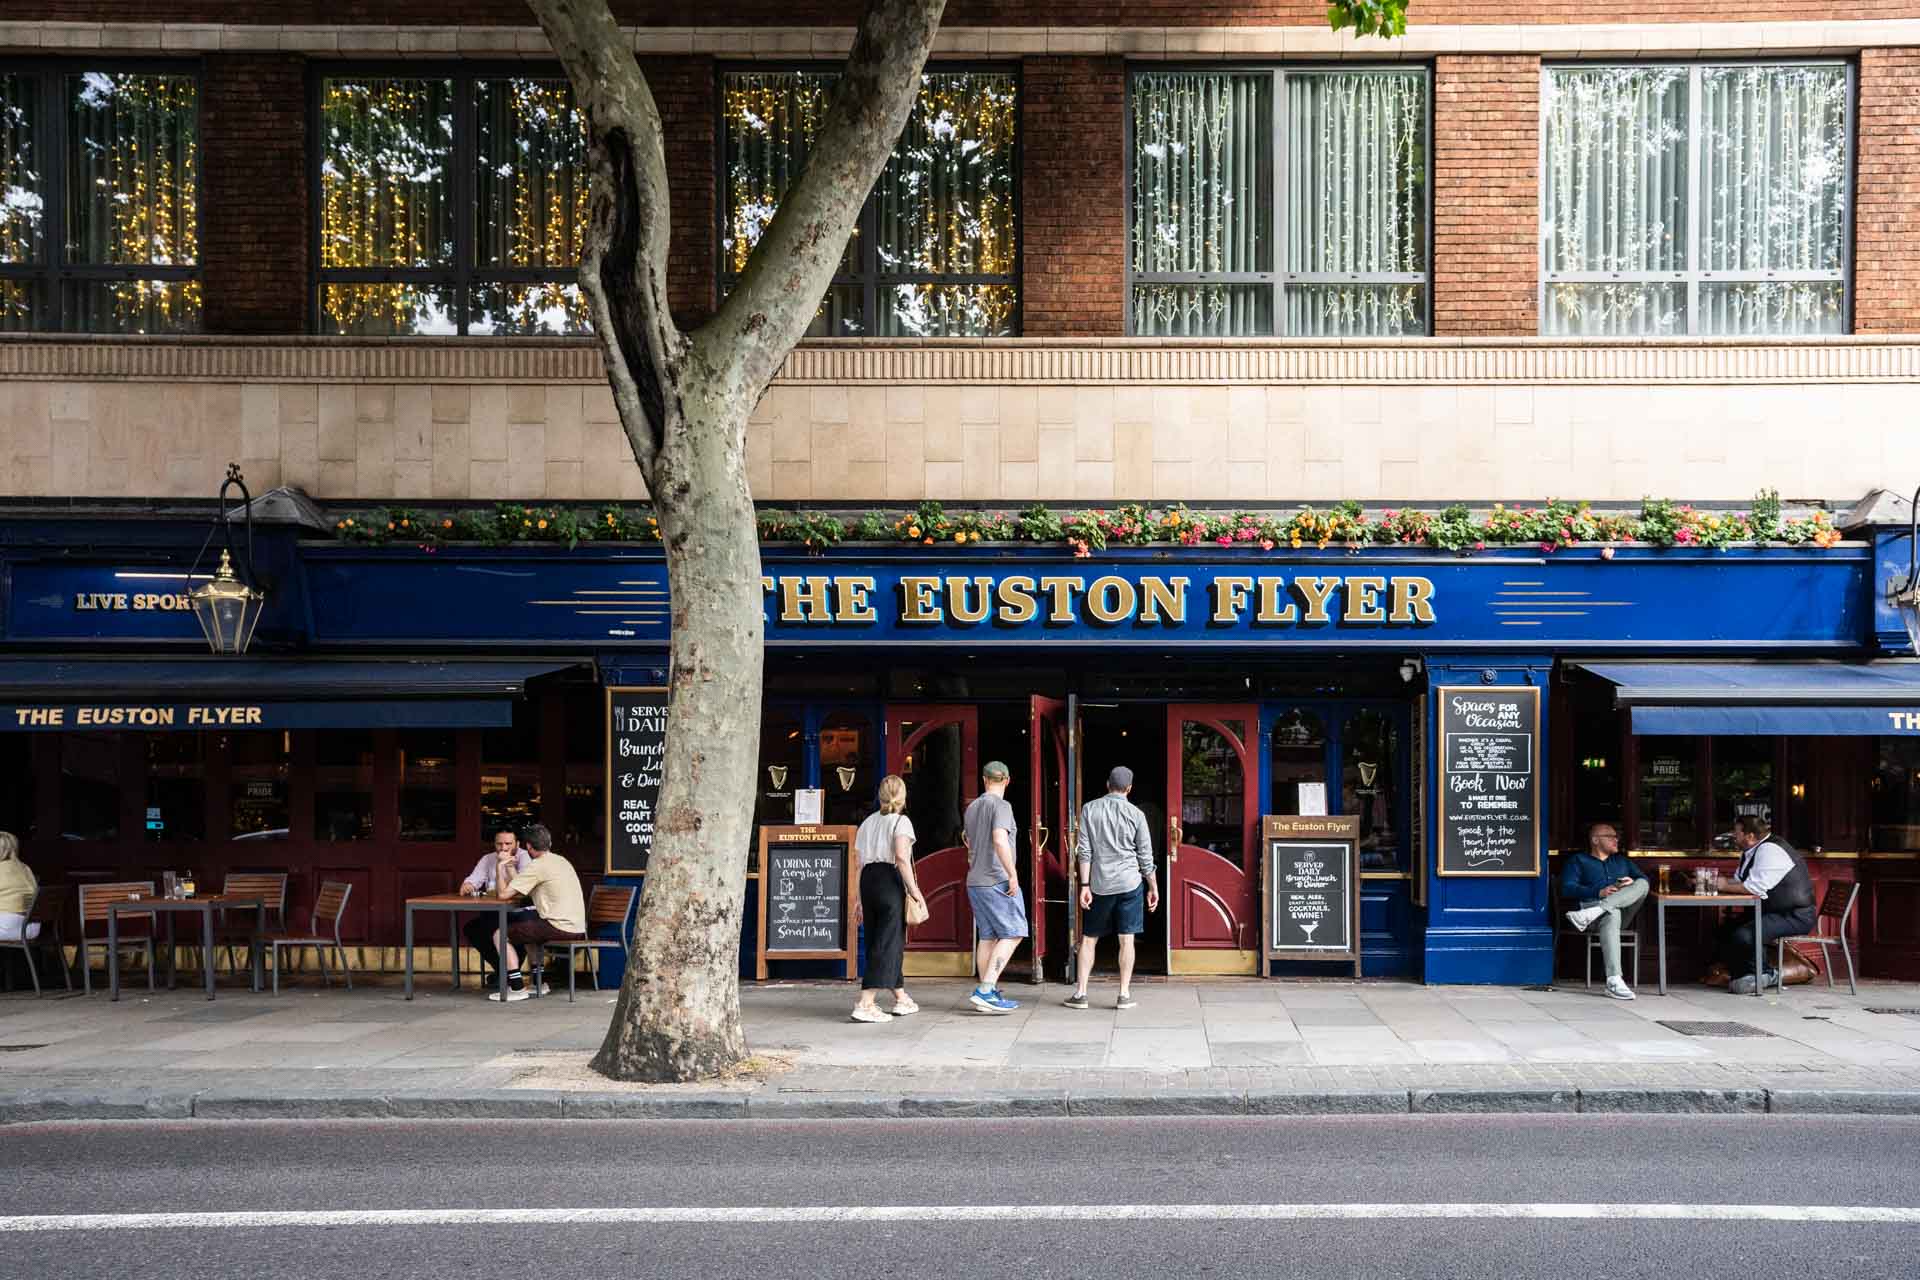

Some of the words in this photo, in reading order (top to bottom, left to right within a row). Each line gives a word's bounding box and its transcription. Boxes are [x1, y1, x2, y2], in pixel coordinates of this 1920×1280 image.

[76, 593, 128, 610] LIVE
[900, 576, 1190, 622] EUSTON
[1213, 576, 1436, 622] FLYER
[1452, 696, 1496, 715] Spaces
[1499, 703, 1518, 712] FOR
[16, 709, 64, 725] THE
[77, 708, 174, 724] EUSTON
[188, 707, 261, 723] FLYER
[1497, 711, 1520, 720] ANY
[1465, 713, 1522, 729] Occasion
[1652, 765, 1681, 775] PRIDE
[1450, 772, 1486, 793] Book
[1495, 774, 1528, 791] Now
[623, 800, 650, 809] REAL
[1460, 801, 1473, 809] TO
[1477, 801, 1518, 809] REMEMBER
[619, 811, 651, 821] CRAFT
[1272, 822, 1290, 831] The
[1292, 822, 1325, 831] Euston
[1327, 822, 1351, 832] Flyer
[773, 858, 781, 869] A
[783, 859, 812, 868] DRINK
[814, 858, 832, 868] FOR
[1294, 861, 1324, 869] SERVED
[1298, 868, 1321, 876] DAILY
[1303, 880, 1329, 889] Dinner
